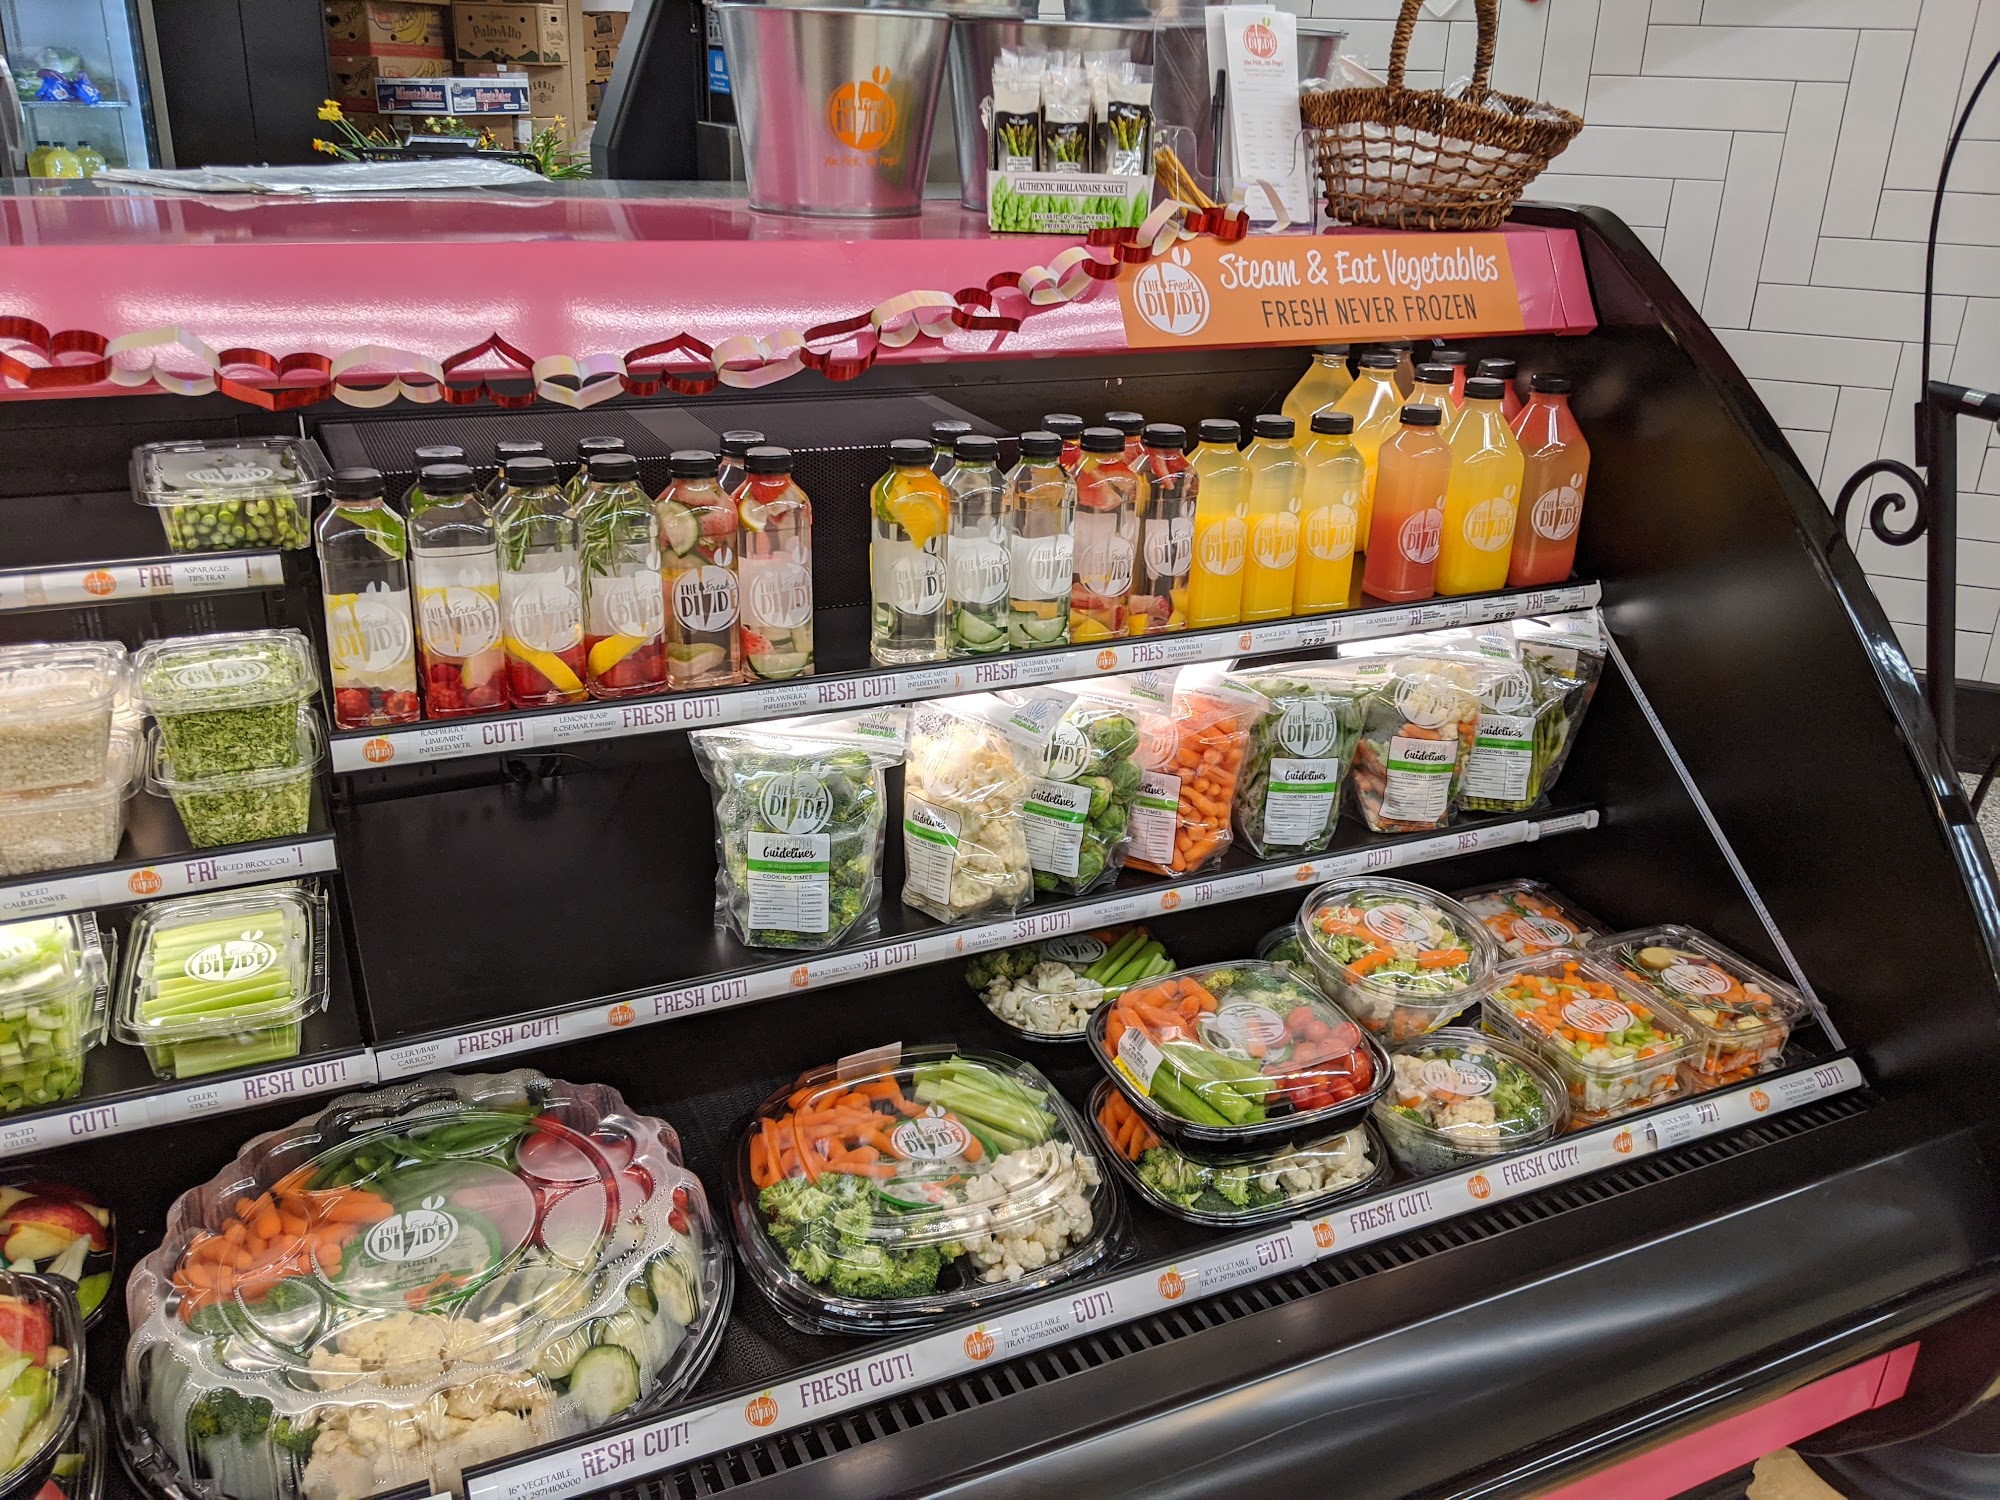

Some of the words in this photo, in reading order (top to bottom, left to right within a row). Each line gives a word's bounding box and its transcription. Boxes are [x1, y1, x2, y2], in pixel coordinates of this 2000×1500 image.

[1018, 182, 1055, 192] AUTHENTIC
[1056, 183, 1102, 193] HOLLANDAISE
[1103, 184, 1124, 194] SAUCE
[1218, 253, 1301, 289] Steam
[1307, 250, 1328, 285] &
[1336, 251, 1380, 284] Eat
[1382, 246, 1499, 291] Vegetables
[1142, 280, 1162, 292] THE
[1167, 278, 1196, 292] Fresh
[1262, 297, 1329, 328] FRESH
[1337, 296, 1398, 325] NEVER
[1403, 293, 1477, 322] FROZEN
[183, 565, 230, 573] ASPARAGUS
[1168, 643, 1204, 653] STRAWBERRY
[1017, 659, 1049, 668] CUCUMBER
[905, 672, 933, 681] ORANGE
[975, 663, 1018, 683] FRESH
[862, 676, 897, 697] CUT!
[907, 679, 933, 688] INFUSED
[763, 692, 808, 703] STRAWBERRY
[763, 702, 792, 711] INFUSED
[793, 699, 808, 707] WTR
[623, 701, 681, 728] FRESH
[683, 698, 721, 719] CUT!
[483, 722, 525, 745] CUT!
[554, 722, 594, 732] ROSEMARY
[858, 722, 897, 732] MICROWAVE
[419, 743, 452, 754] INFUSED
[453, 741, 472, 749] WTR
[1404, 750, 1448, 762] Guidelines
[1285, 771, 1328, 781] Guidelines
[1030, 789, 1077, 809] Guidelines
[912, 809, 947, 830] Guidelines
[1026, 813, 1053, 825] COOKING
[1054, 819, 1071, 829] TIMES
[763, 846, 816, 858] Guidelines
[1367, 849, 1393, 867] CUT!
[216, 864, 244, 872] RICED
[245, 857, 290, 869] BROCCOLI
[3, 893, 67, 909] CAULIFLOWER
[19, 887, 49, 899] RICED
[1041, 912, 1071, 935] CUT!
[884, 944, 918, 966] CUT!
[808, 969, 831, 978] MICRO
[653, 987, 706, 1016] FRESH
[711, 978, 749, 1003] CUT!
[457, 1027, 515, 1055] FRESH
[520, 1016, 560, 1040] CUT!
[390, 1043, 440, 1061] CELERY/BABY
[398, 1054, 436, 1067] CARROTS
[302, 1062, 348, 1089] CUT!
[1814, 1065, 1845, 1089] CUT!
[187, 1090, 219, 1103] CELERY
[189, 1099, 219, 1111] STICKS
[69, 1107, 119, 1136] CUT!
[4, 1127, 34, 1140] DICED
[4, 1135, 38, 1149] CELERY
[1501, 1154, 1547, 1187] FRESH
[1548, 1145, 1579, 1173] CUT!
[1349, 1204, 1396, 1234] FRESH
[1397, 1189, 1434, 1219] CUT!
[1255, 1236, 1293, 1266] CUT!
[1214, 1258, 1249, 1274] VEGETABLE
[1200, 1277, 1217, 1287] TRAY
[1072, 1291, 1114, 1324] CUT!
[1021, 1316, 1061, 1332] VEGETABLE
[1006, 1337, 1026, 1349] TRAY
[1026, 1323, 1070, 1342] 29716200000
[799, 1367, 862, 1408] FRESH
[867, 1352, 914, 1387] CUT!
[643, 1421, 690, 1457] CUT!
[522, 1468, 572, 1490] VEGETABLE
